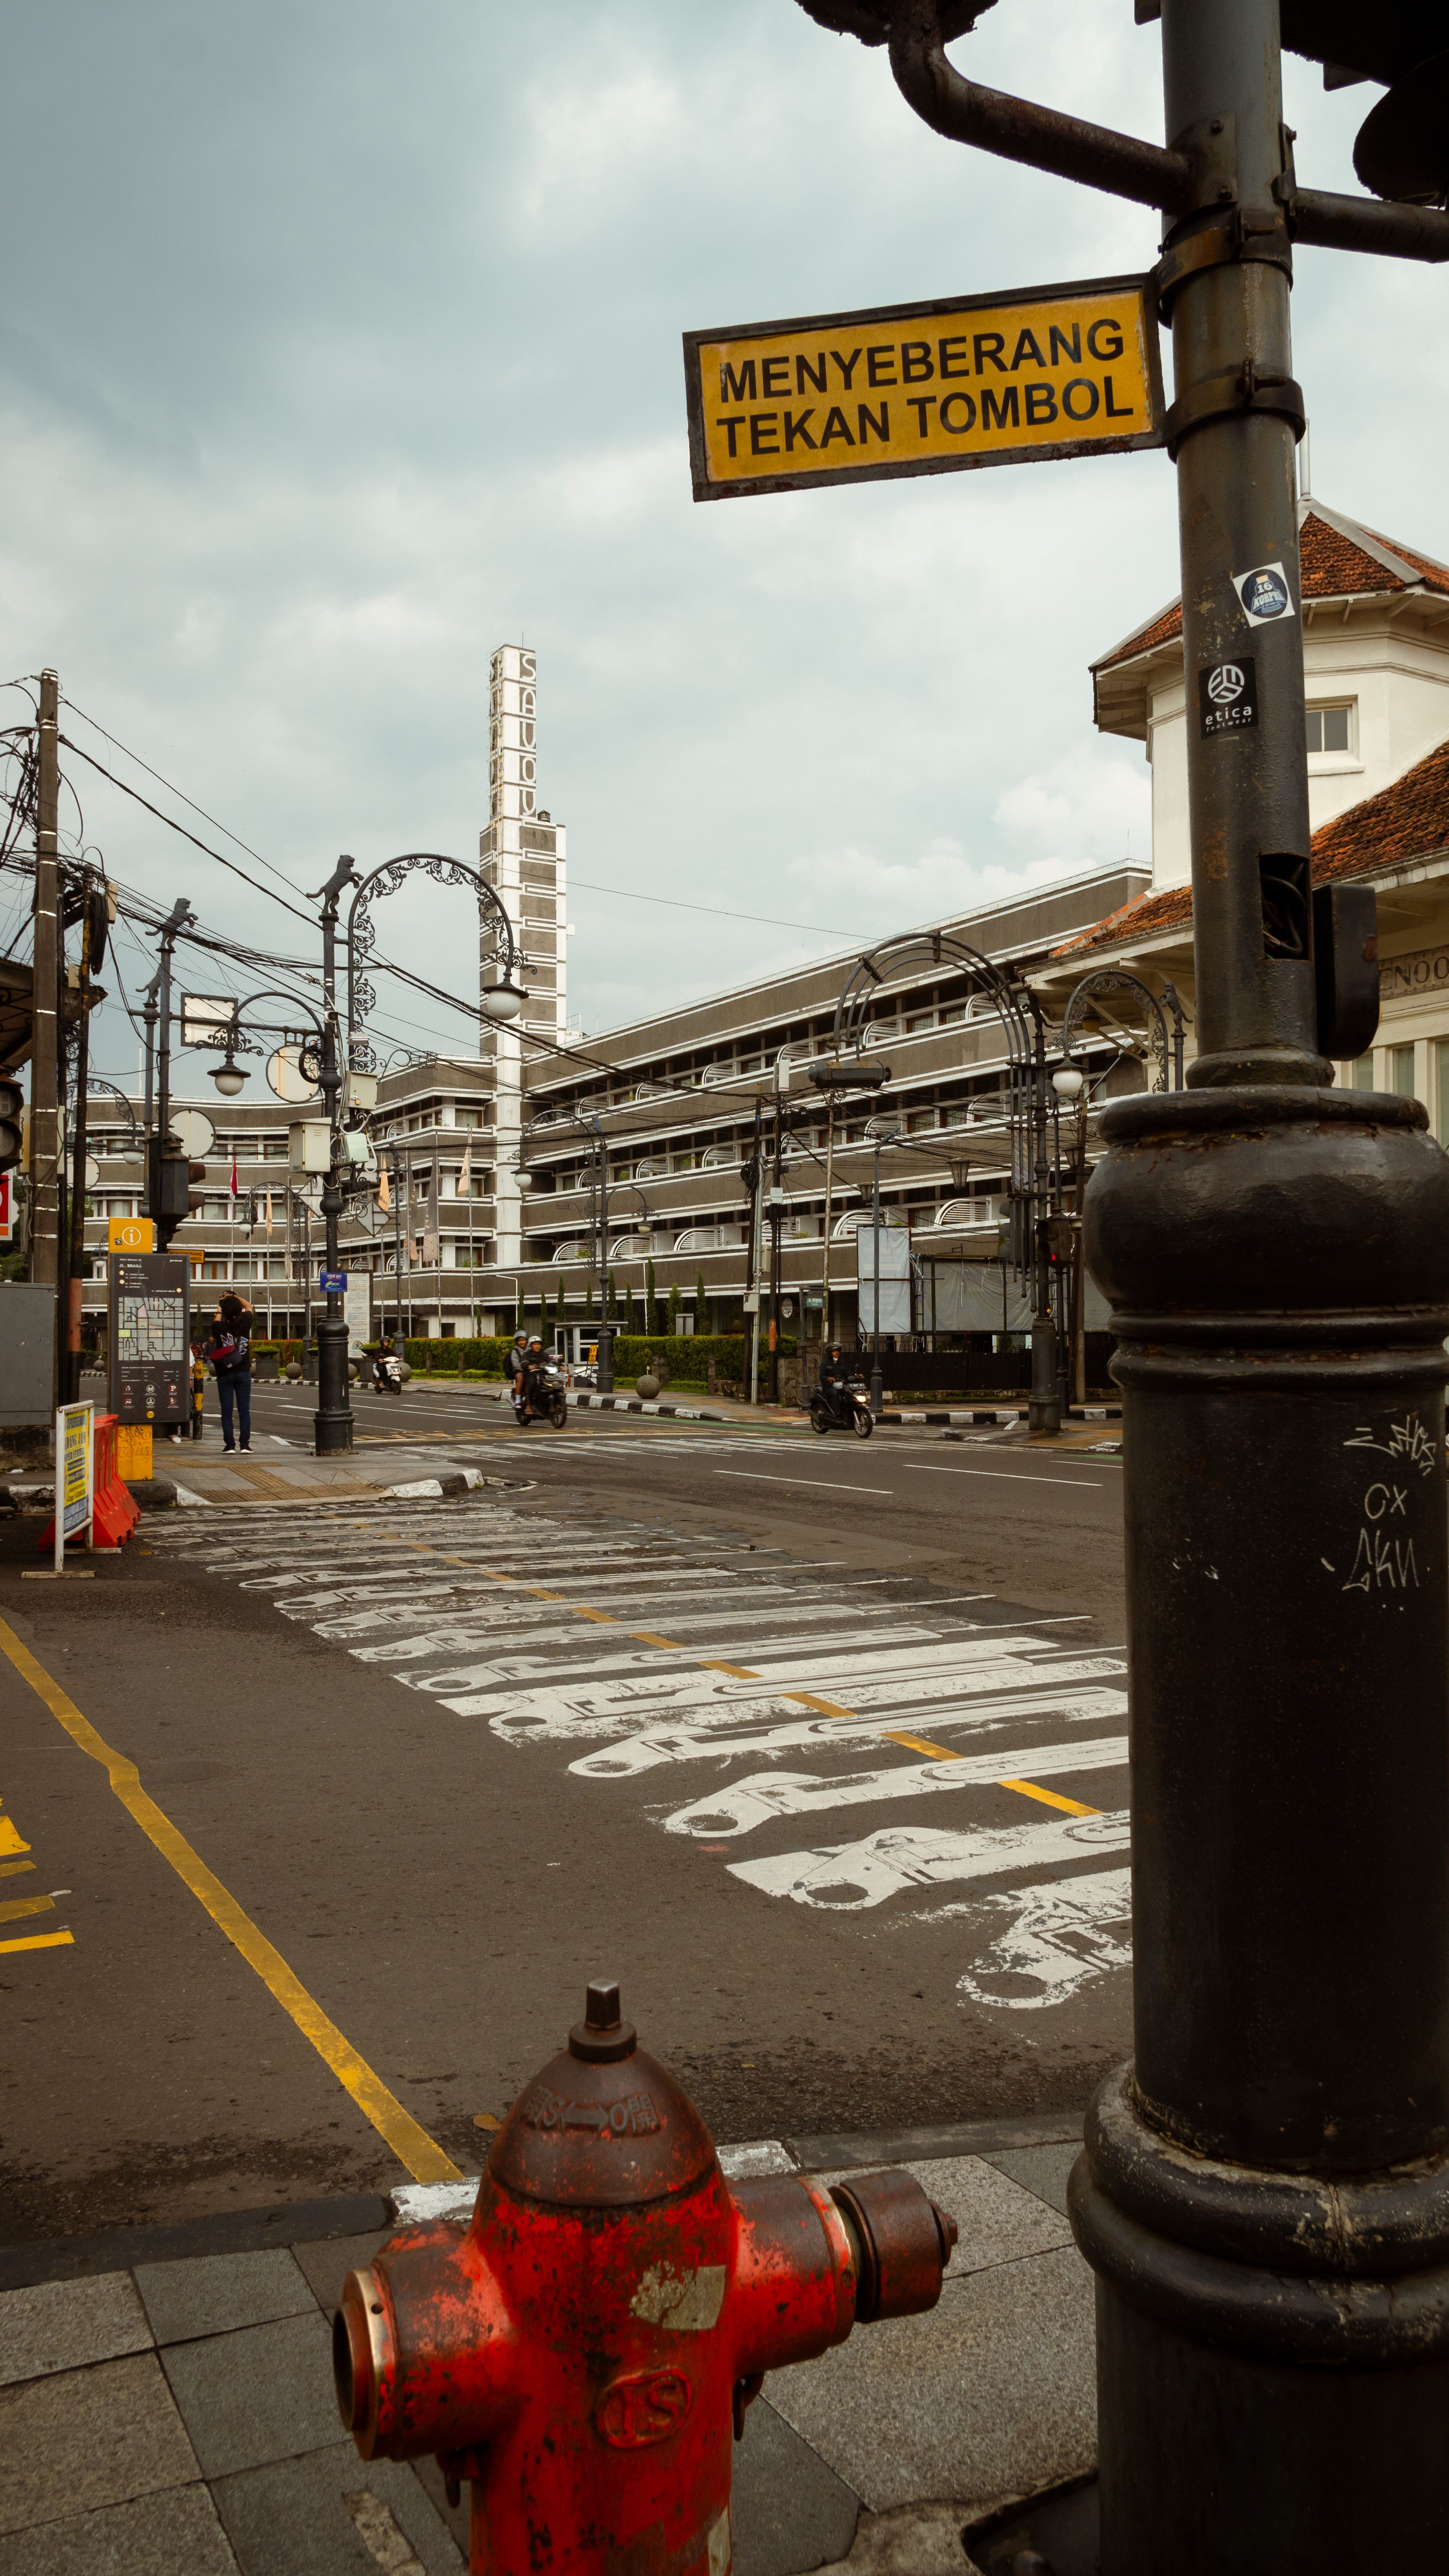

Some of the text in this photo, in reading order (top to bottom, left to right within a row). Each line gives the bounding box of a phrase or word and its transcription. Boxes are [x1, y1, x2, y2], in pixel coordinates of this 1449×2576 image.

[719, 319, 1124, 403] MENYEBERANG
[717, 376, 1134, 458] TEKAN TOMBOL
[1257, 582, 1273, 593] 16
[1206, 706, 1252, 725] etica
[1206, 717, 1252, 732] footwear
